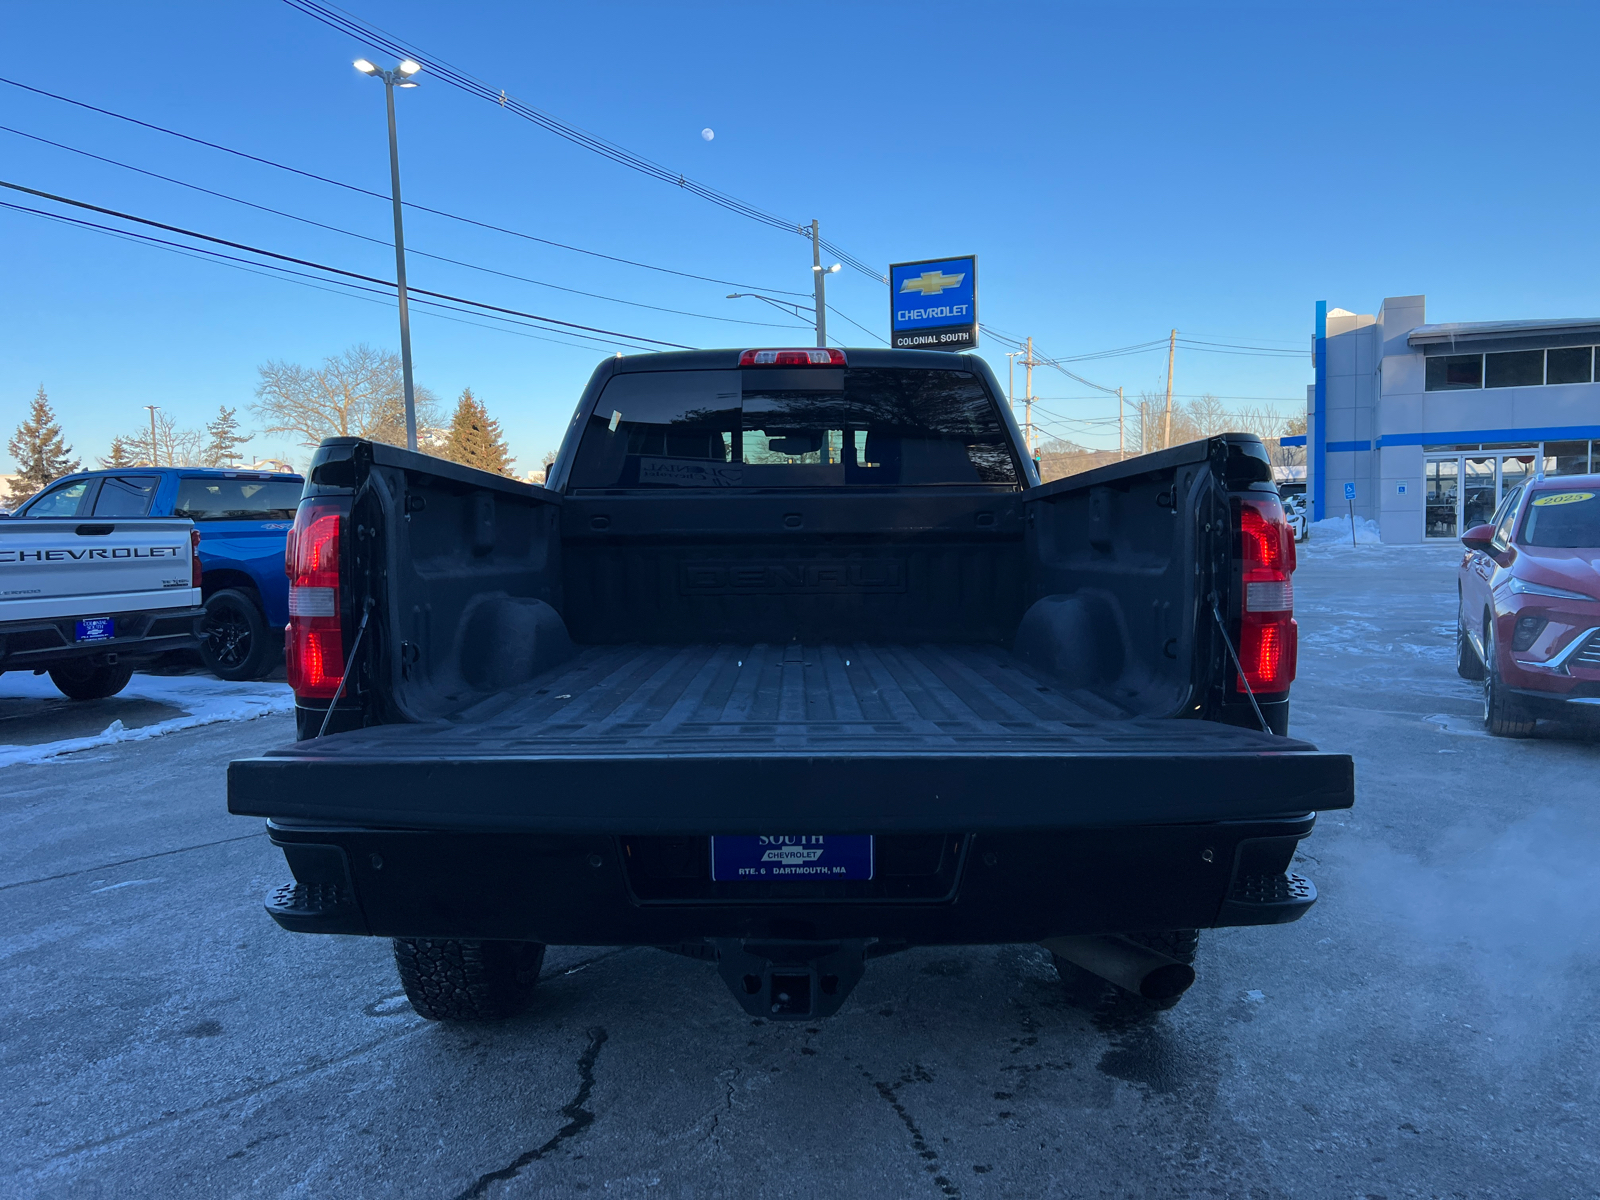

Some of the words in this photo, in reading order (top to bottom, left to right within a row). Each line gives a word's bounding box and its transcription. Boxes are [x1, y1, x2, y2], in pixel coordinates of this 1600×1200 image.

[898, 305, 968, 321] CHEVROLET
[897, 335, 938, 346] COLONIAL
[940, 332, 969, 342] SOUTH
[1544, 495, 1583, 504] 2025
[0, 546, 181, 562] CHEVROLET
[687, 565, 900, 588] DENALI
[767, 851, 818, 859] CHEVROLET
[773, 867, 831, 875] DARTMOUTH,
[832, 866, 846, 874] MA
